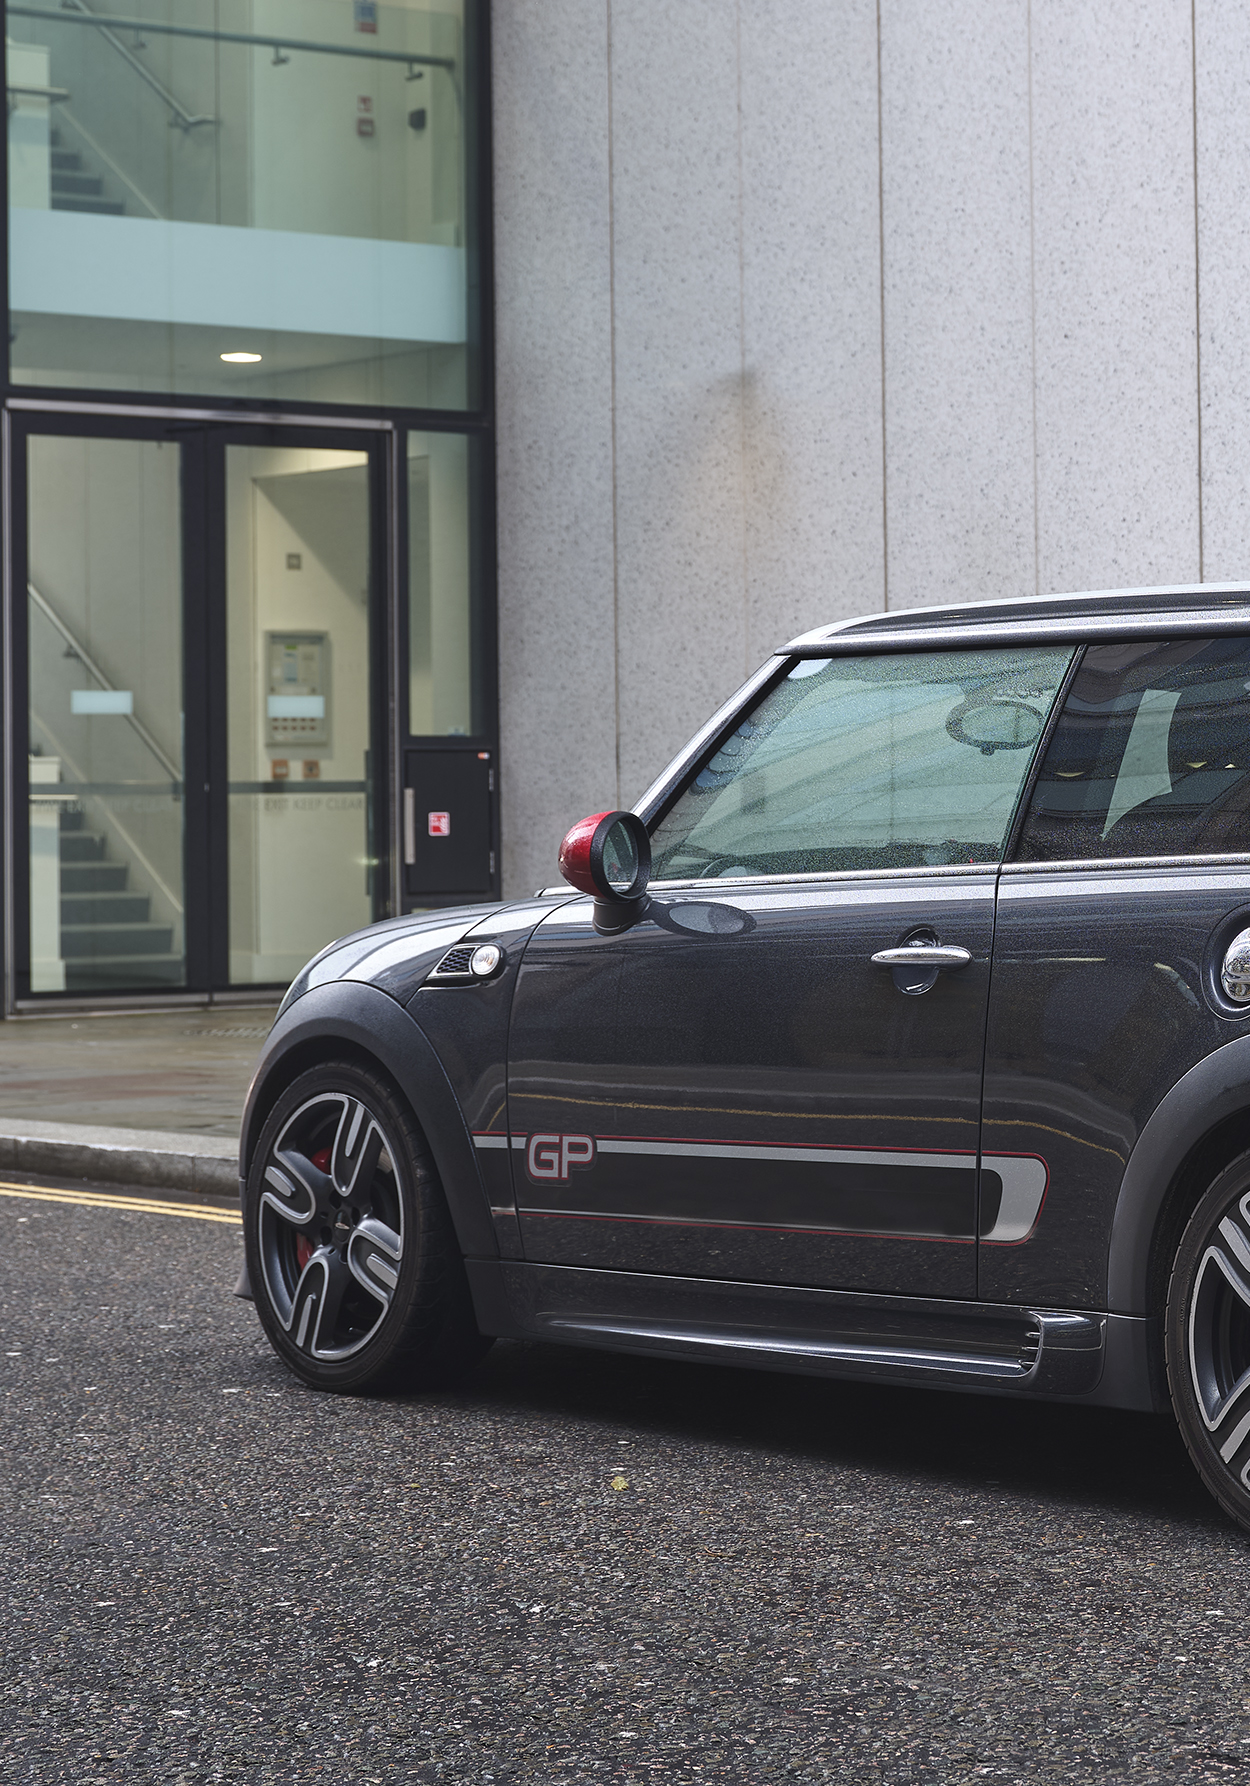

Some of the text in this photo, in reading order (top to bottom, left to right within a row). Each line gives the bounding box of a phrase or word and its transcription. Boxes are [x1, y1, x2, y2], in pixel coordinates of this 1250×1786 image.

[292, 798, 322, 812] KEEP
[325, 797, 363, 812] CLEAR
[528, 1133, 594, 1180] GP
